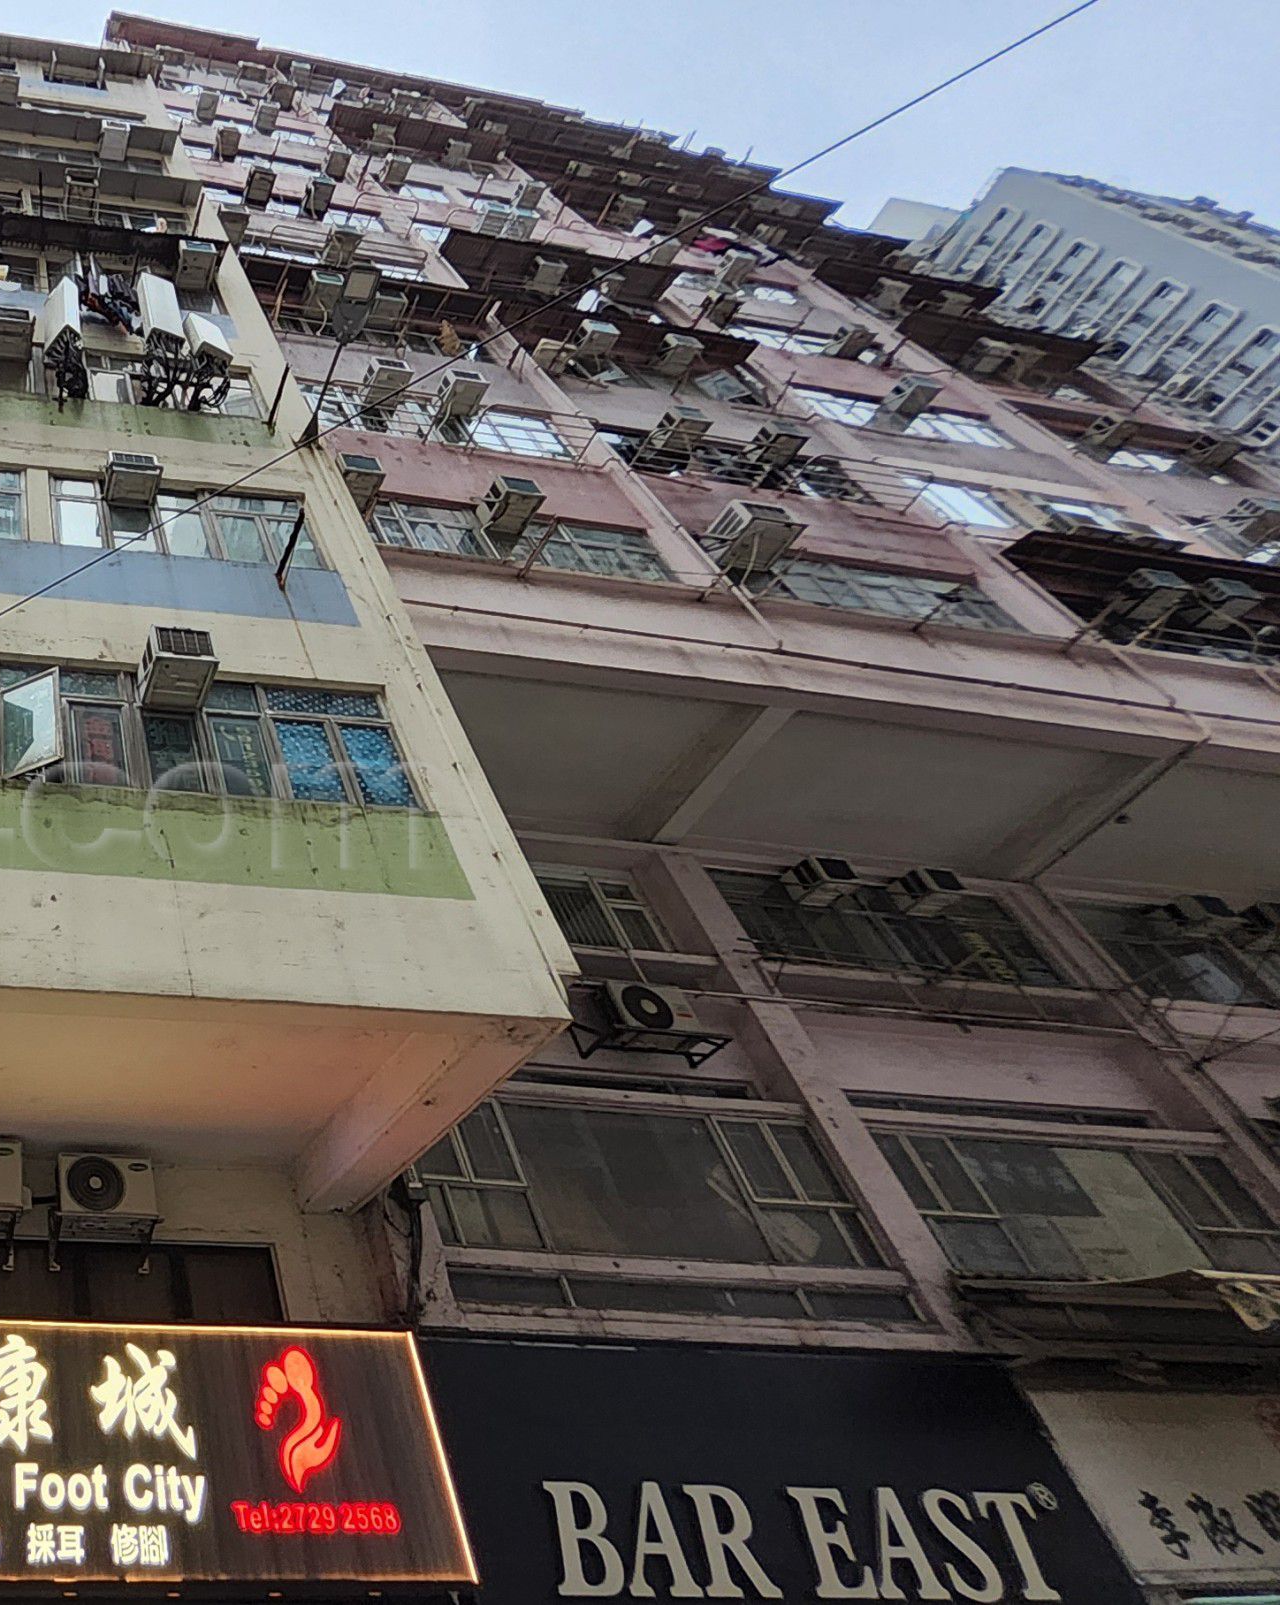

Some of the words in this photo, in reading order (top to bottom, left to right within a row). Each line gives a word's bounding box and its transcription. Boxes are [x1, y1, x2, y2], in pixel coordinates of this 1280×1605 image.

[14, 1462, 108, 1510] Foot
[123, 1466, 207, 1524] City
[339, 1502, 400, 1534] 2568
[27, 1522, 85, 1565] 採耳
[110, 1523, 168, 1566] 修腳
[542, 1481, 783, 1598] BAR
